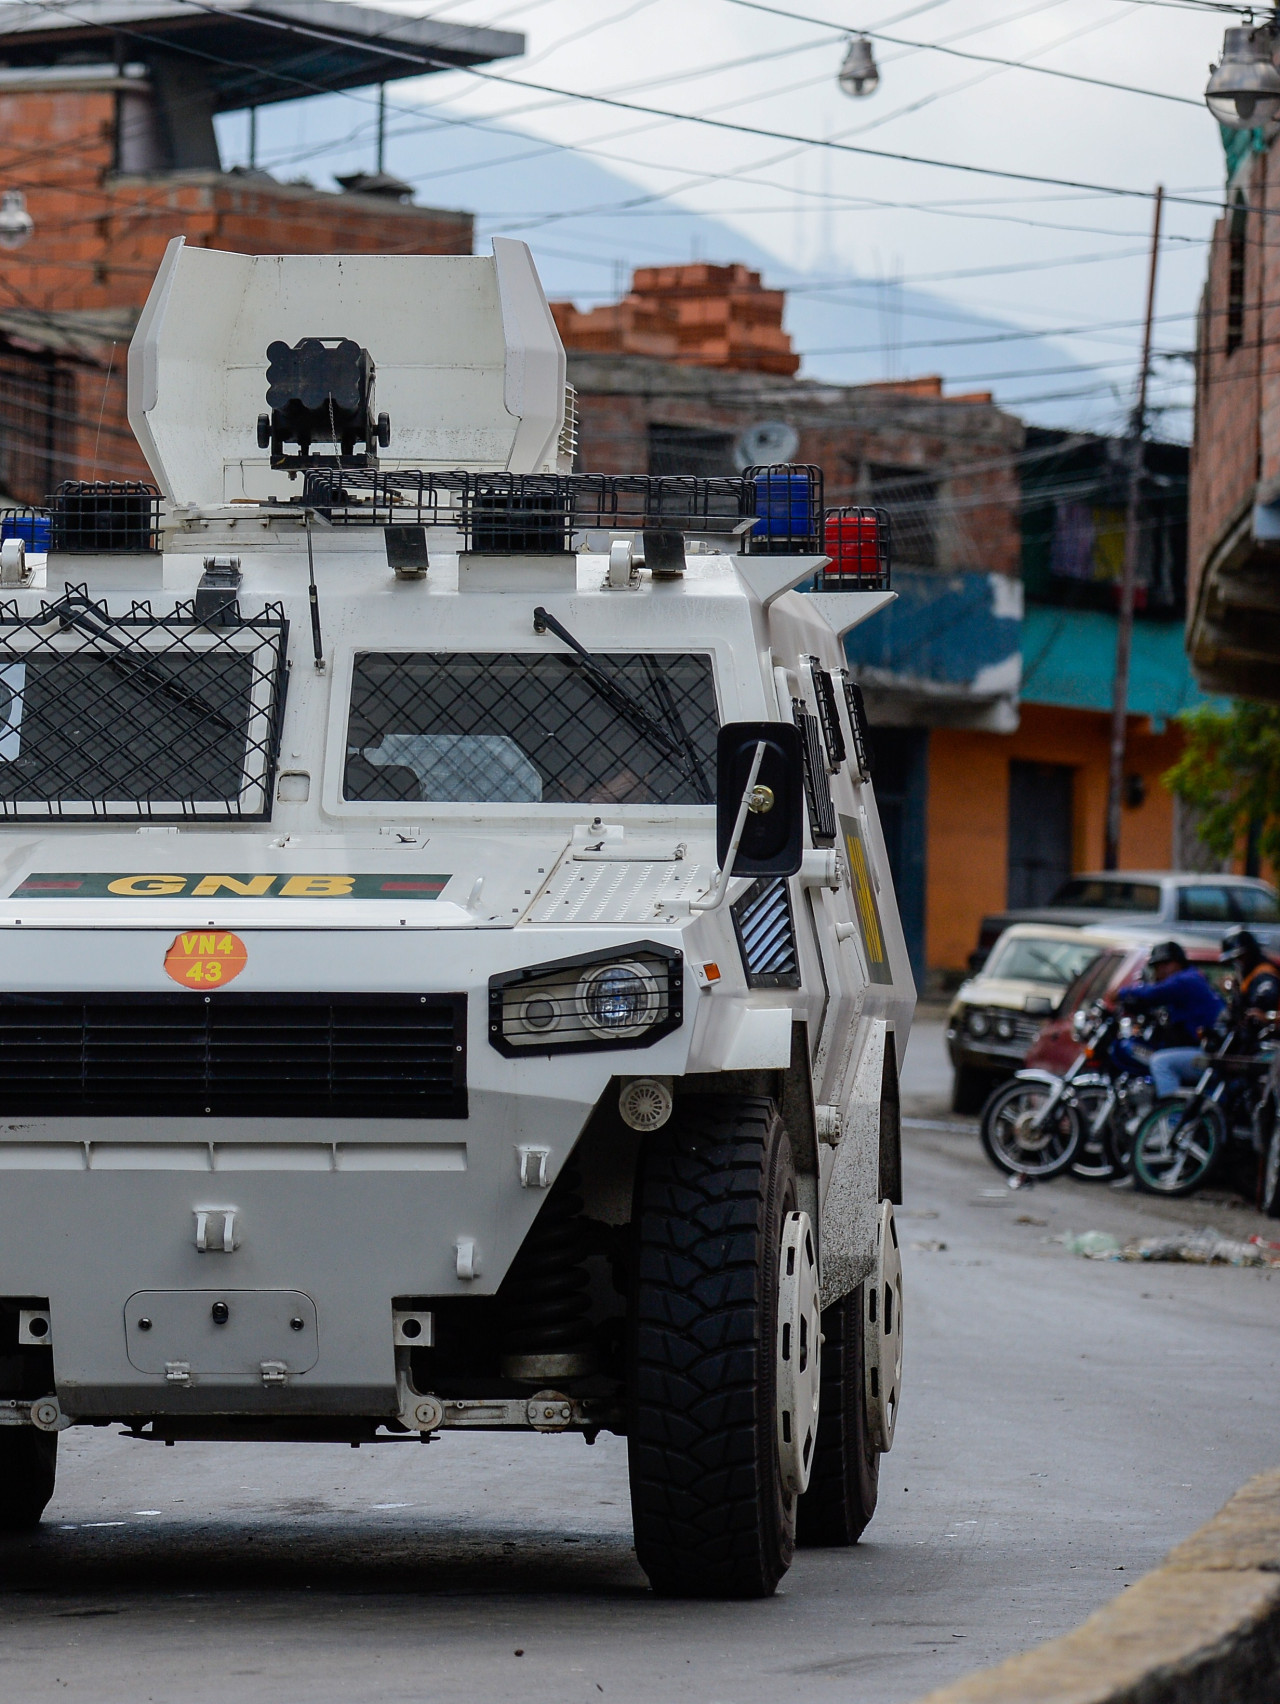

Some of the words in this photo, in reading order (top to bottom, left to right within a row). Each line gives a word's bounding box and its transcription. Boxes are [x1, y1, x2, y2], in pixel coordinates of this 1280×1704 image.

[107, 875, 356, 897] GNB
[181, 935, 233, 955] VN4
[186, 962, 222, 982] 43
